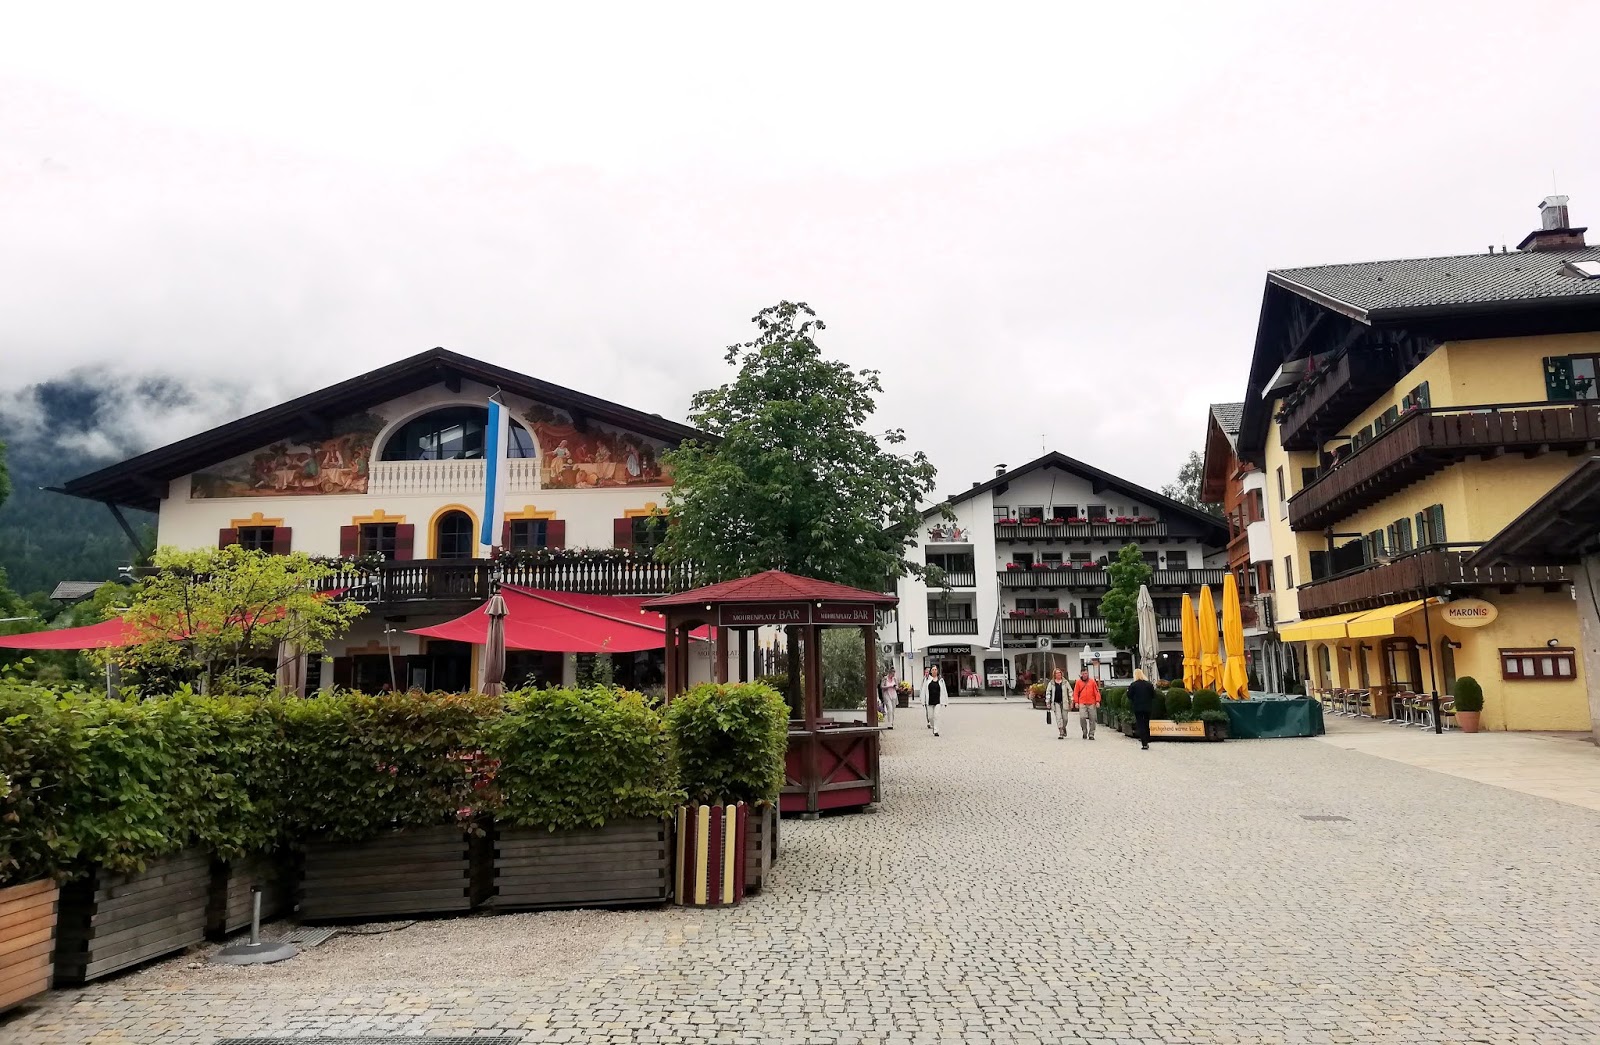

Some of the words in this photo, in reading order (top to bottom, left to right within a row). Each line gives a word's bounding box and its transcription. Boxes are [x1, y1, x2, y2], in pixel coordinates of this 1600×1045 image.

[732, 613, 777, 621] MOHRENPLATZ
[778, 609, 800, 620] BAR
[853, 609, 868, 620] BAR
[1449, 608, 1487, 617] MARONIS
